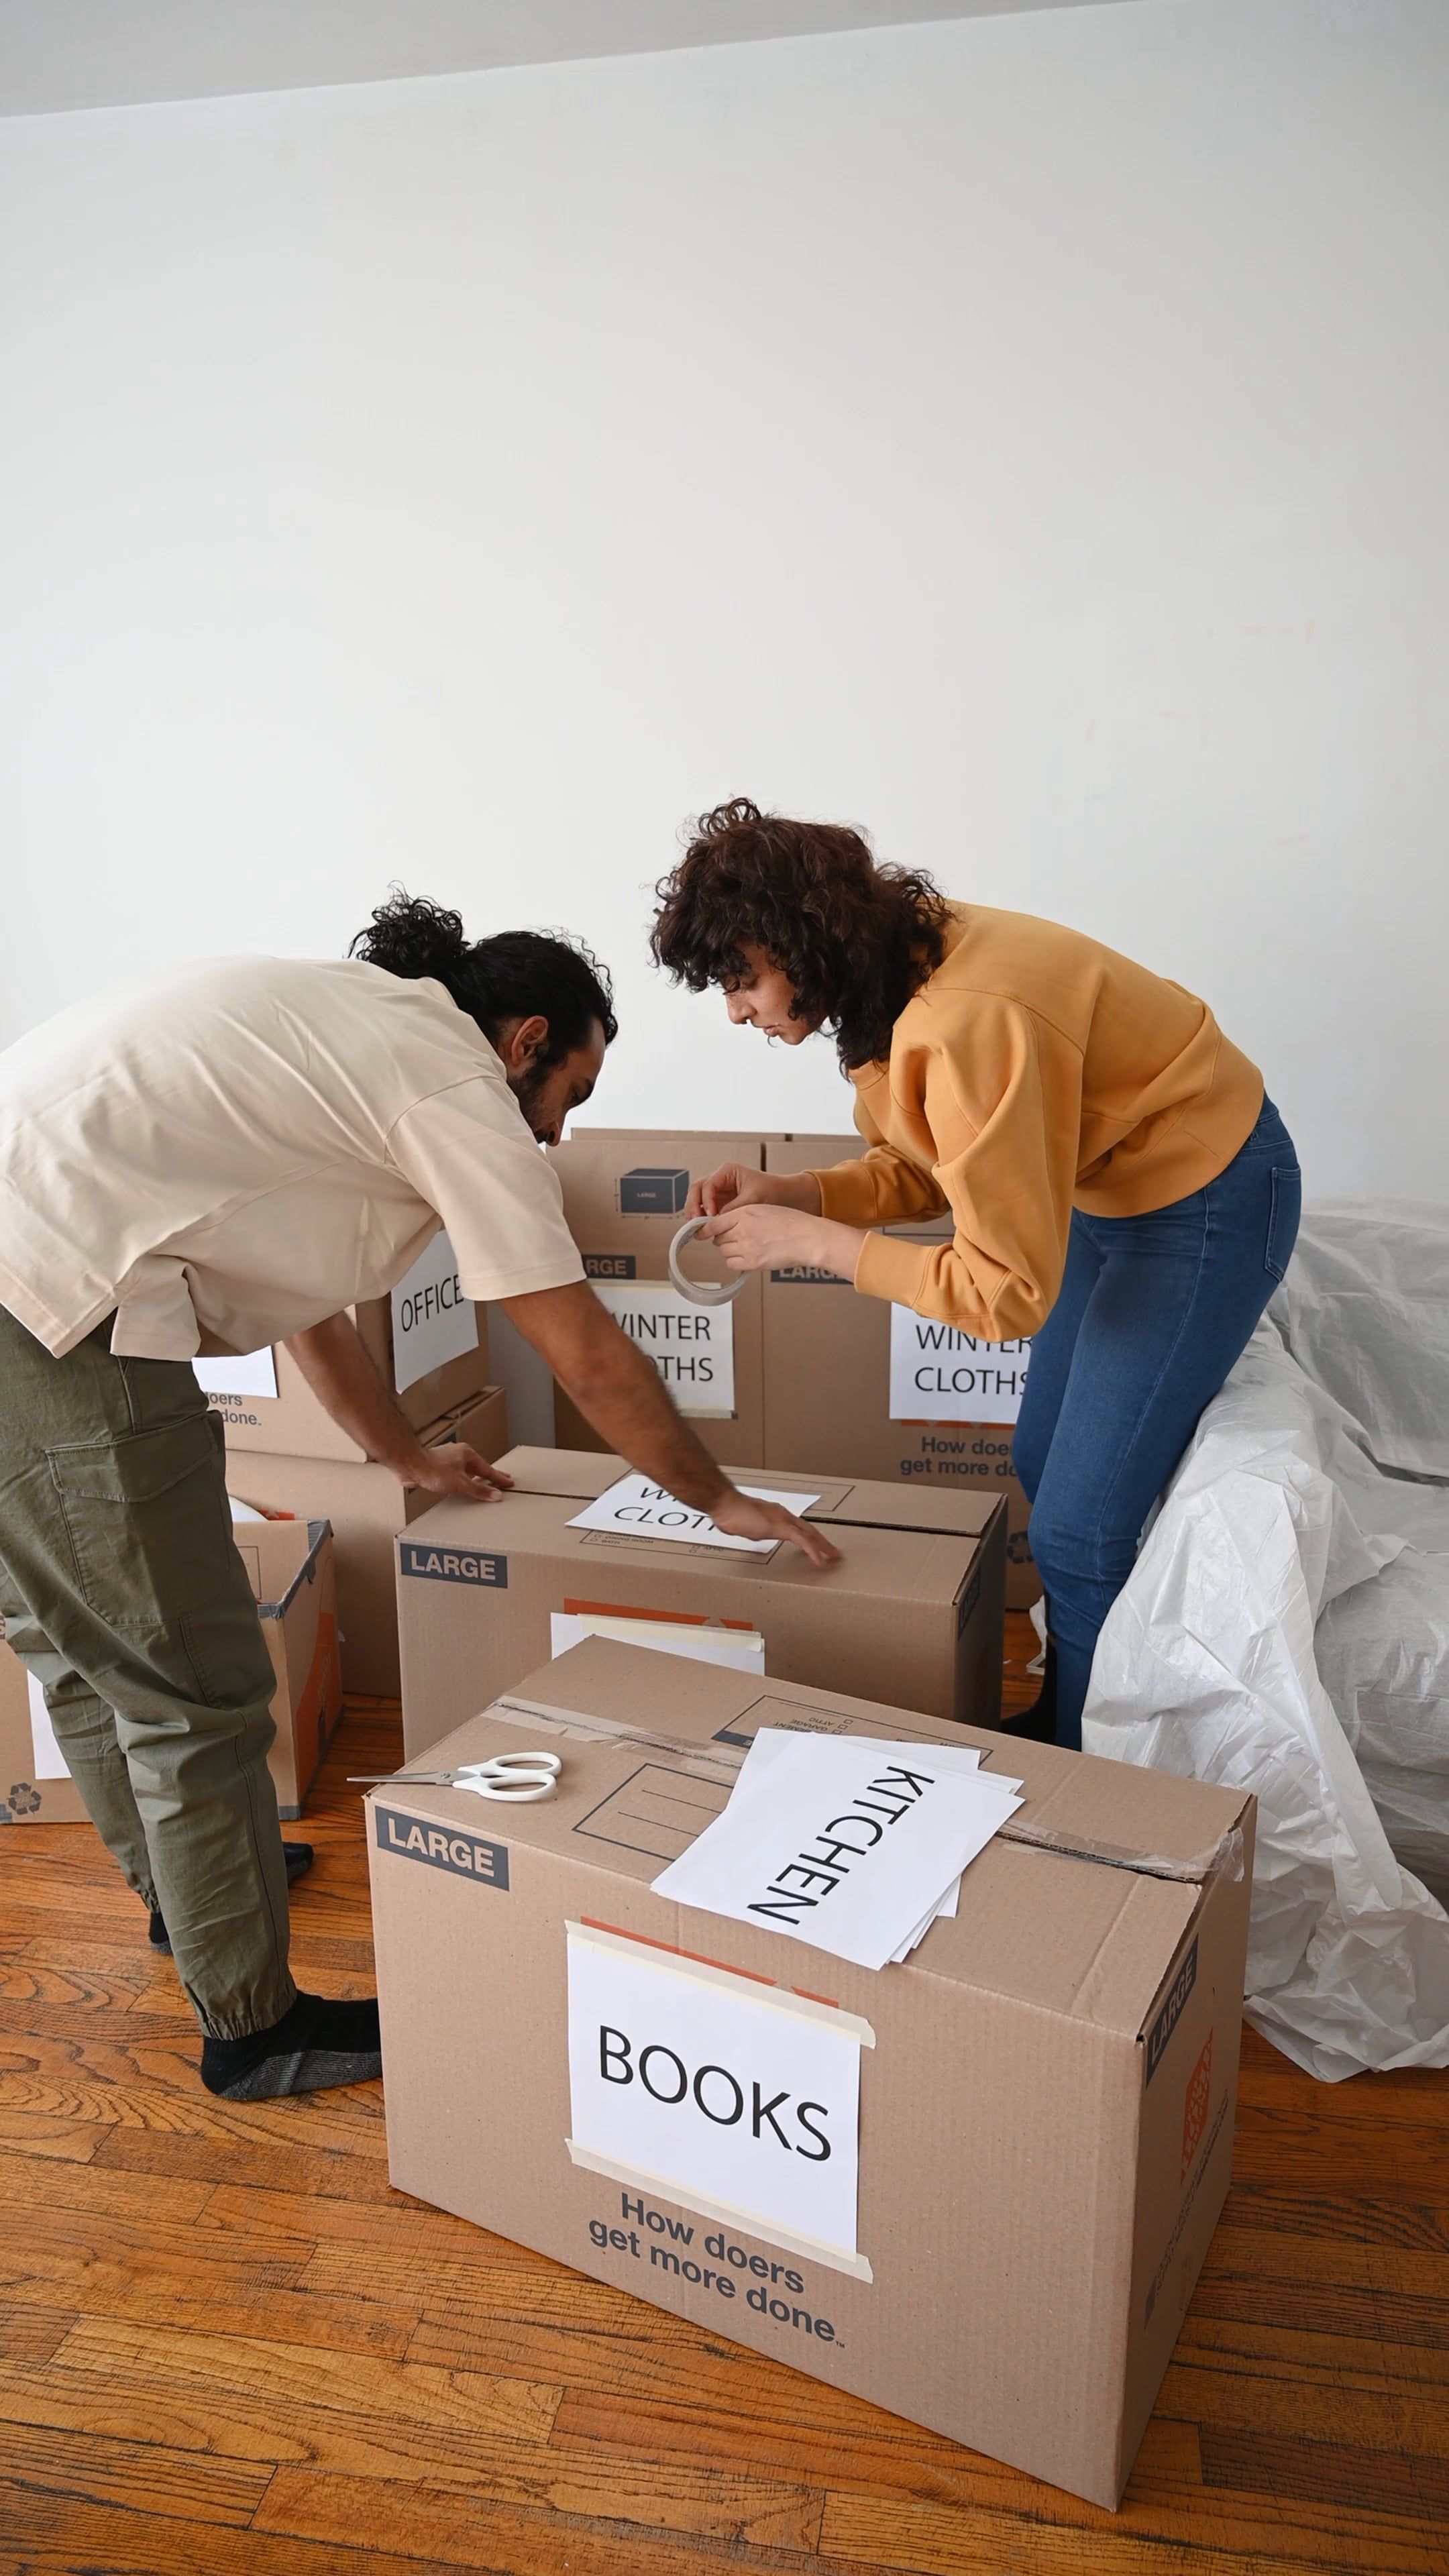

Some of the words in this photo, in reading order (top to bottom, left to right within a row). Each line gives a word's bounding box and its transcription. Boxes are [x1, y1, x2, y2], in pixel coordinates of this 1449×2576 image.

[586, 1259, 627, 1275] RGE
[779, 1265, 837, 1279] LAR
[401, 1275, 464, 1332] OFFICE
[648, 1354, 714, 1383] THS
[205, 1392, 243, 1407] oers
[921, 1437, 965, 1454] How
[971, 1439, 1012, 1456] doe
[900, 1458, 932, 1476] get
[938, 1462, 989, 1476] more
[995, 1460, 1018, 1477] do
[614, 1506, 714, 1531] CLOT
[411, 1550, 496, 1580] LARGE
[773, 1721, 812, 1733] EMENT
[790, 1719, 828, 1731] GARAGE
[808, 1717, 835, 1727] ATTIC
[388, 1817, 494, 1878] LARGE
[747, 1766, 935, 1925] KITCHEN
[1150, 1953, 1194, 2067] LARGE
[600, 2025, 832, 2162] BOOKS
[621, 2192, 694, 2247] How
[704, 2233, 804, 2294] doers
[589, 2219, 641, 2259] get
[650, 2245, 736, 2300] more
